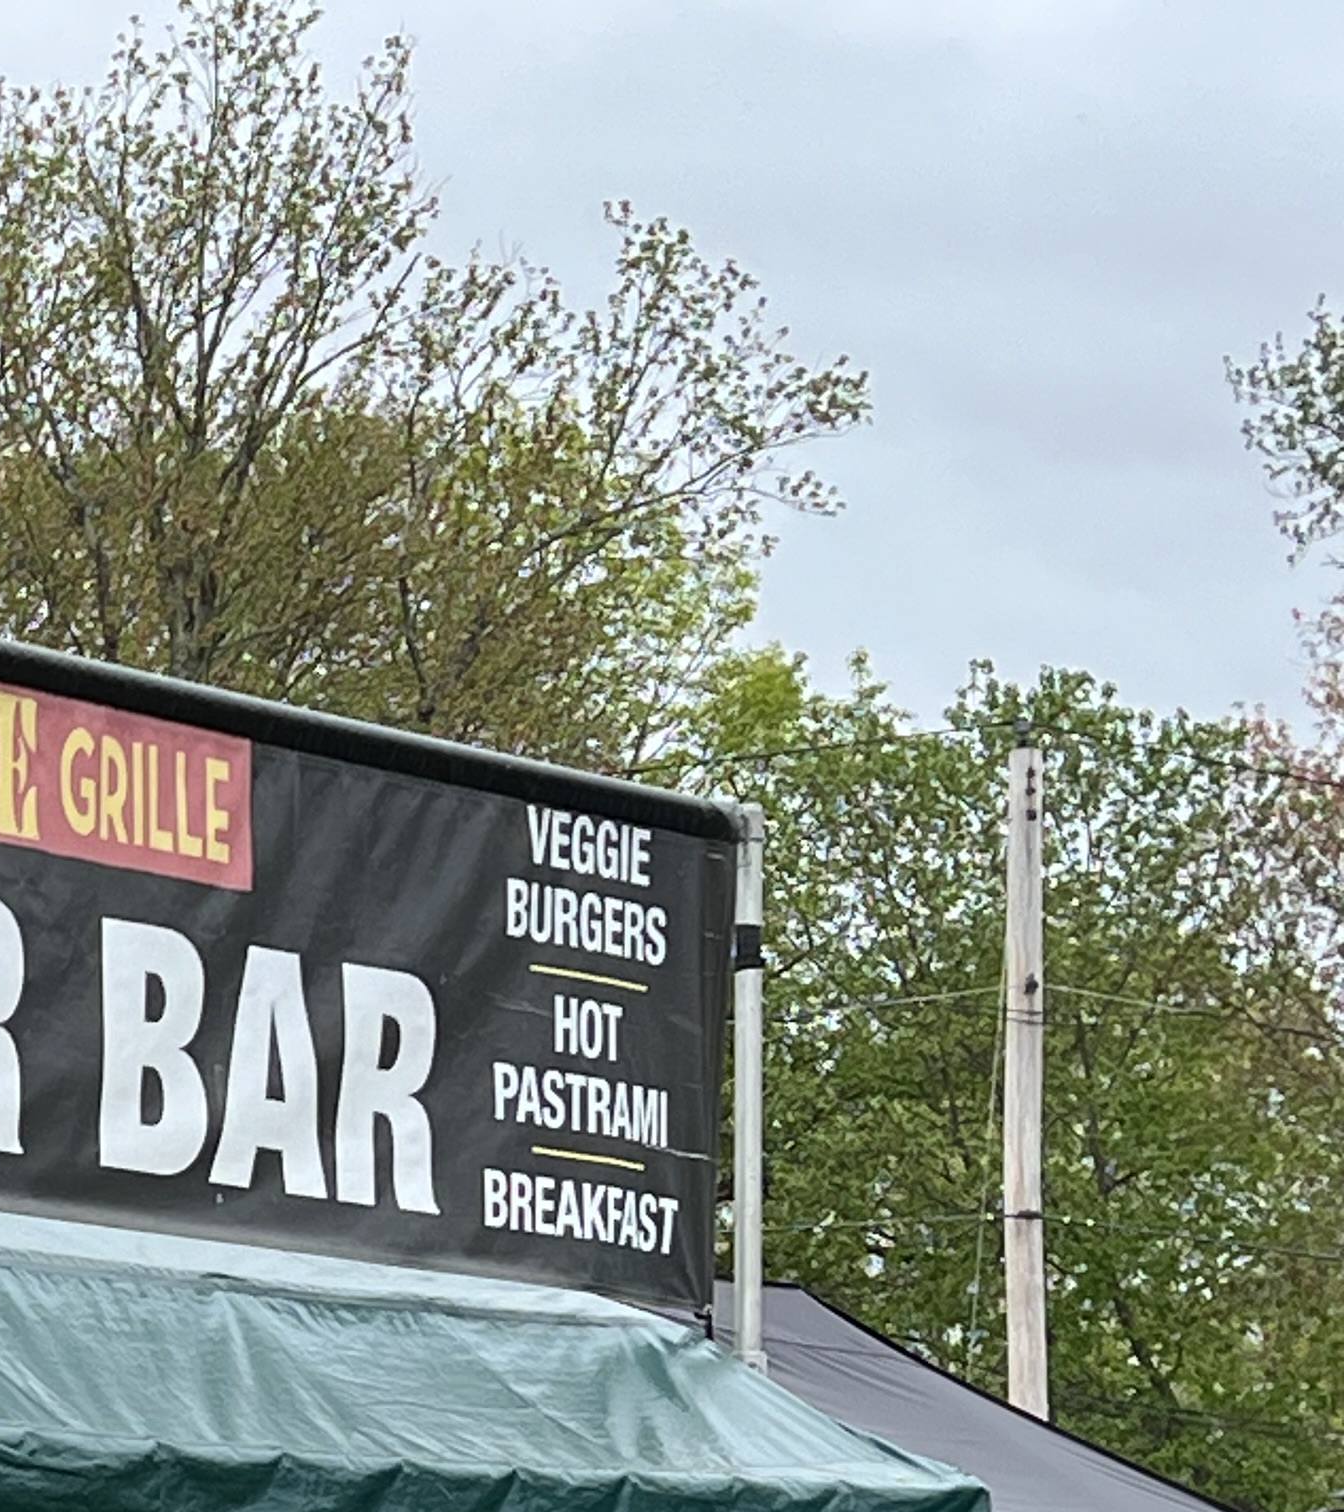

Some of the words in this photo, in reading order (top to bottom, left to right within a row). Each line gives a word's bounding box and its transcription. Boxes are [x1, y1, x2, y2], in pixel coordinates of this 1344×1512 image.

[60, 726, 231, 864] GRILLE
[526, 805, 652, 887] VEGGIE
[506, 878, 667, 966] BURGERS
[99, 917, 441, 1216] BAR
[553, 995, 622, 1063] HOT
[493, 1062, 668, 1149] PASTRAMI
[484, 1169, 679, 1255] BREAKFAST
